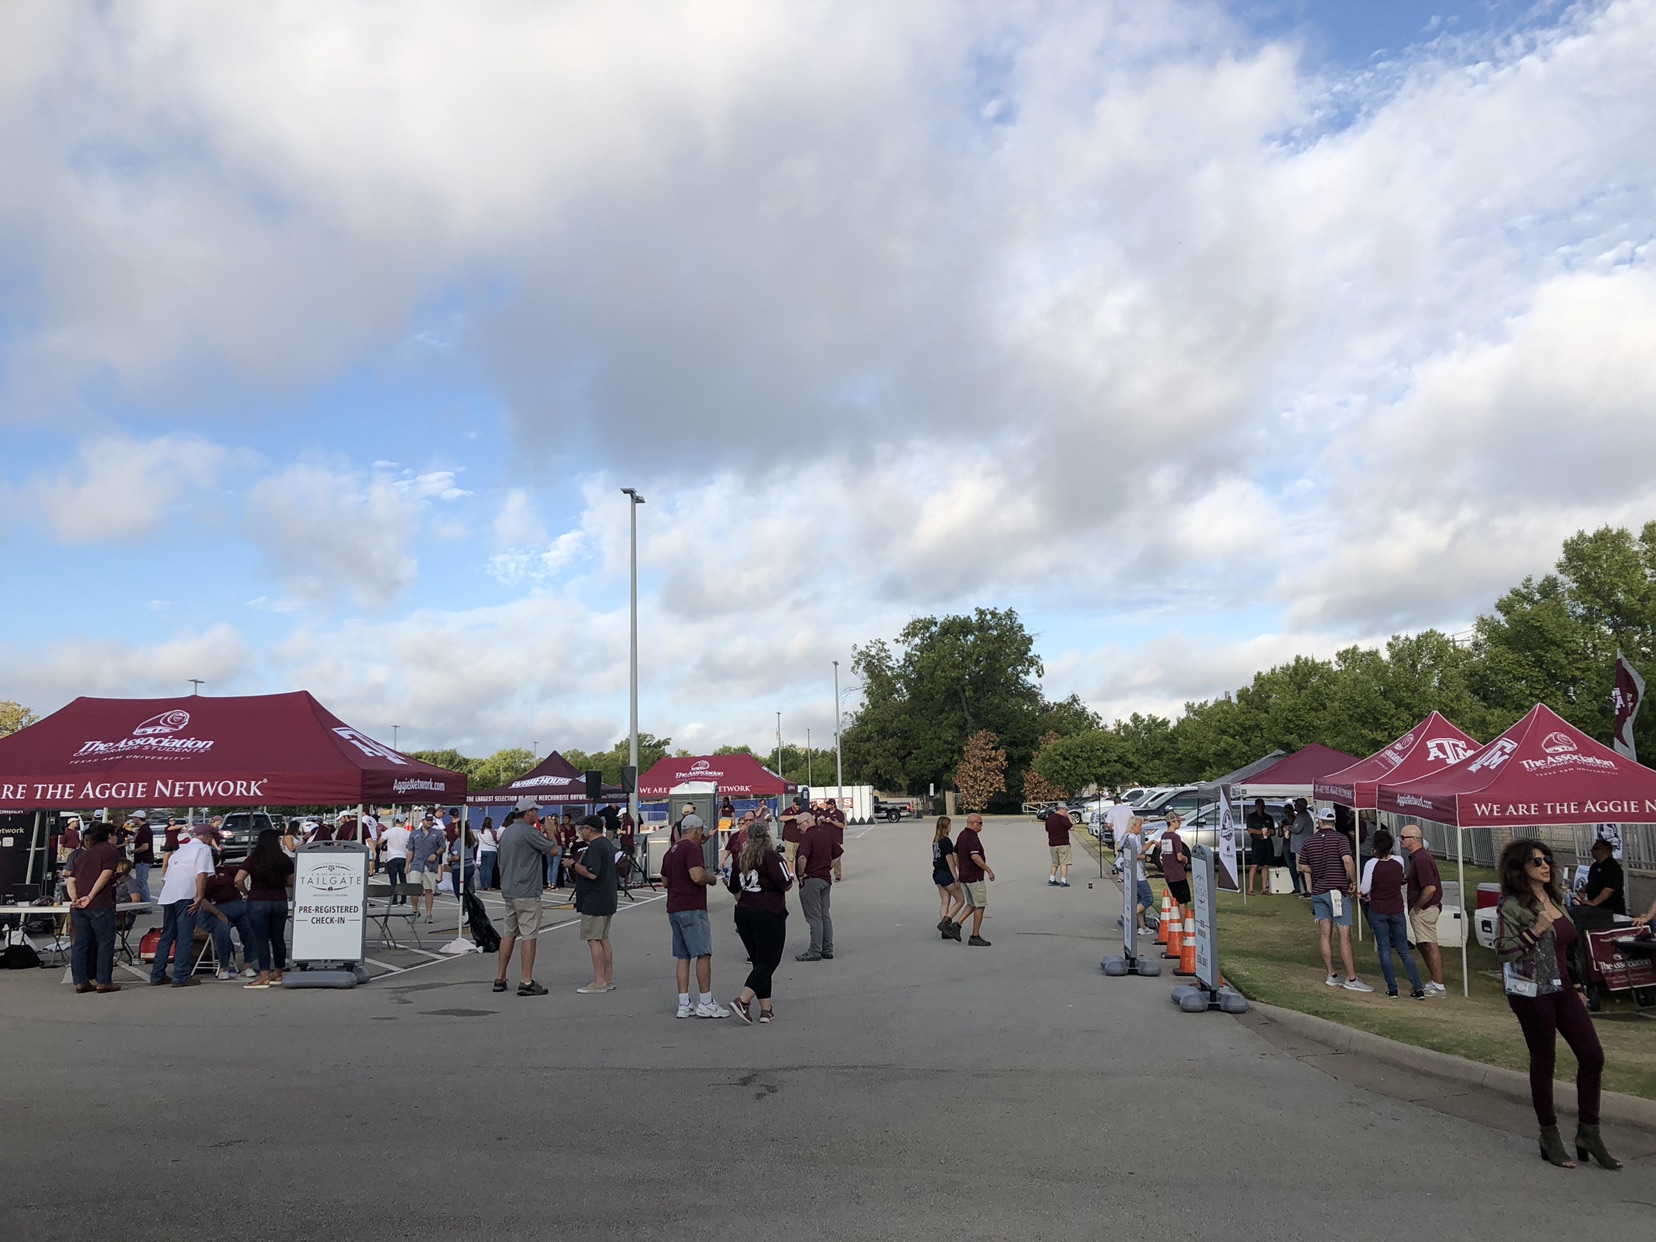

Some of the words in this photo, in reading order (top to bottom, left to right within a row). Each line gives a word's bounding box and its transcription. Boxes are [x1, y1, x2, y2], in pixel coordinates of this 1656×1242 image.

[79, 741, 113, 752] The
[115, 735, 214, 750] Association
[1520, 759, 1547, 769] The
[1547, 753, 1615, 768] Association
[33, 783, 75, 799] THE
[78, 781, 148, 799] AGGIE
[393, 778, 445, 793] AggieNetwork.com
[639, 786, 651, 794] WE
[653, 786, 667, 794] ARE
[718, 785, 750, 793] ETWORK
[1473, 803, 1501, 816] WE
[1505, 803, 1539, 816] ARE
[1544, 802, 1579, 815] THE
[1584, 800, 1640, 813] AGGIE
[300, 876, 362, 885] TAILGATE
[298, 905, 359, 913] PRE-REGISTERED
[311, 916, 346, 924] CHECK-IN
